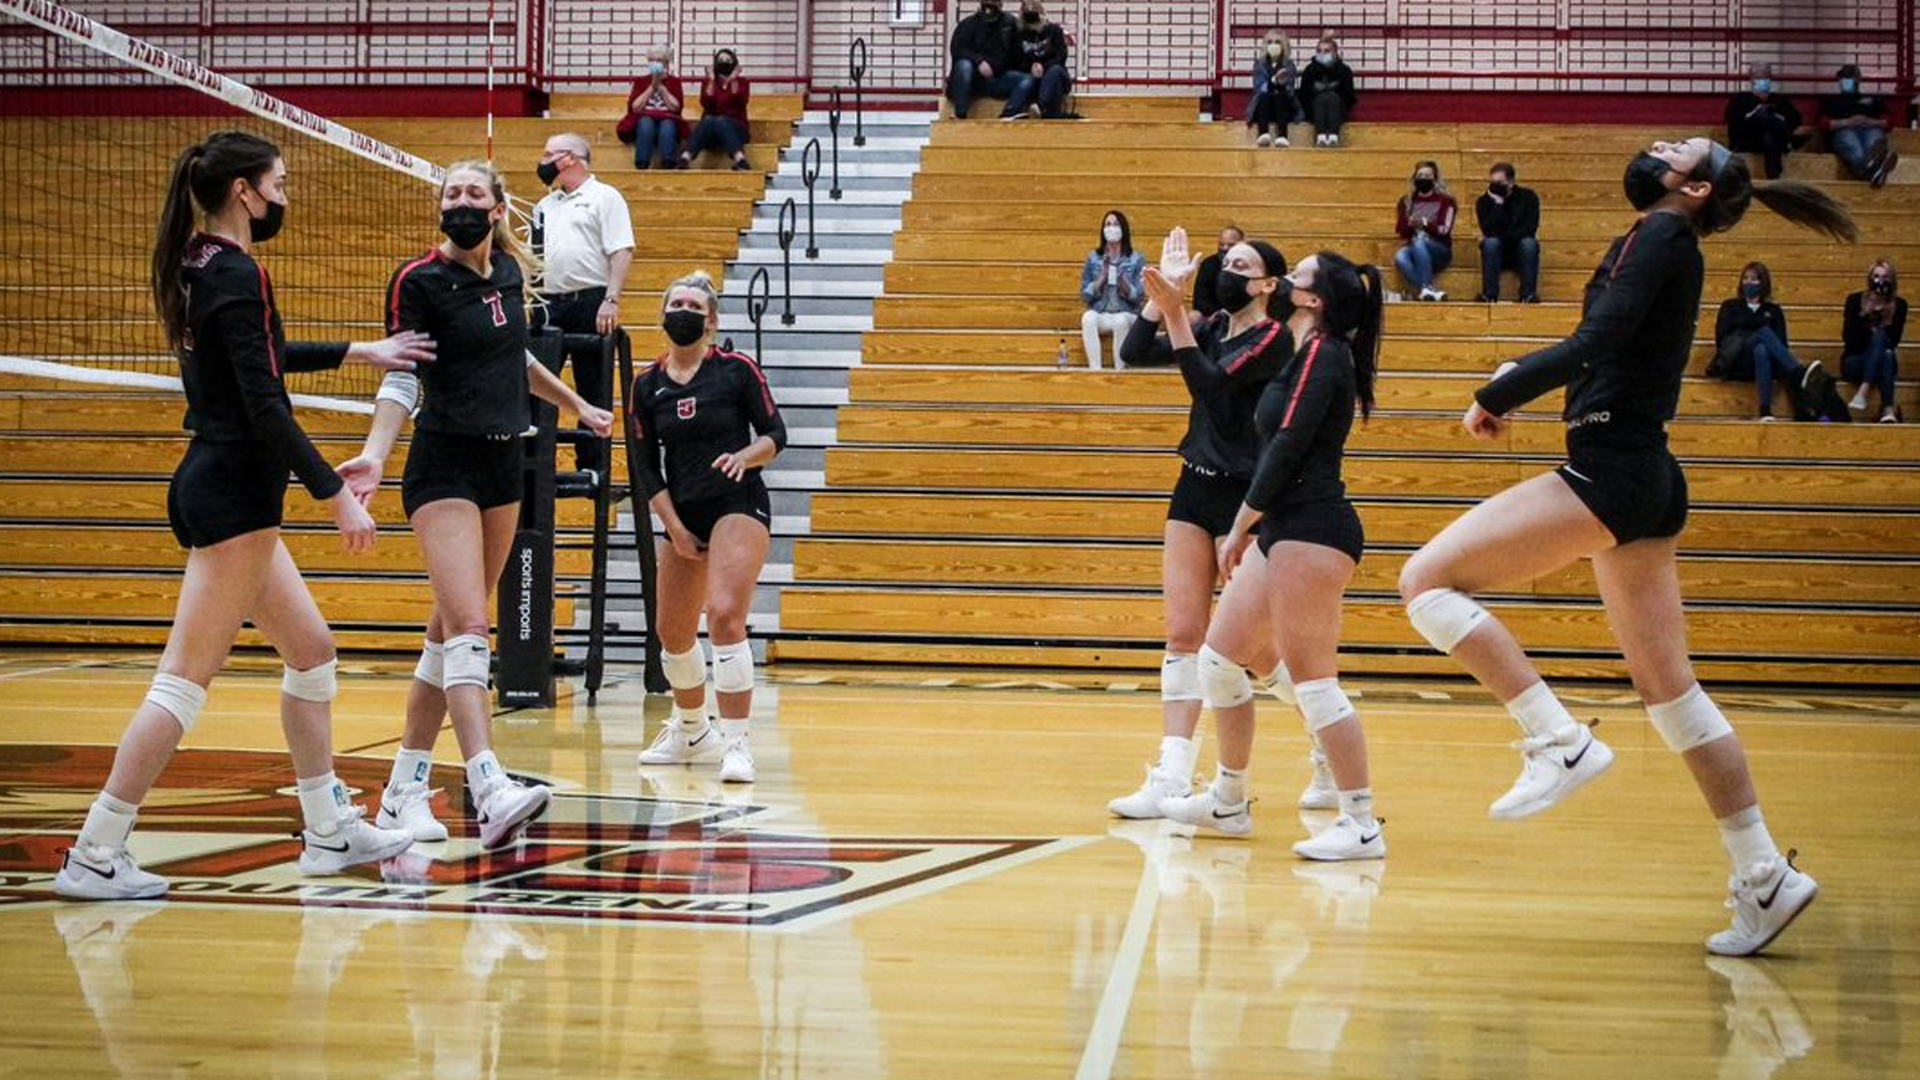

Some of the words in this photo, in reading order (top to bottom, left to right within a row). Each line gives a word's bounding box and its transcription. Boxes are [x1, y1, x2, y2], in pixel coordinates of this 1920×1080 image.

[481, 290, 507, 327] 7
[677, 396, 697, 419] 5
[520, 547, 534, 589] sports
[518, 590, 533, 640] imports
[167, 881, 448, 899] OUTH
[466, 892, 770, 912] BEND
